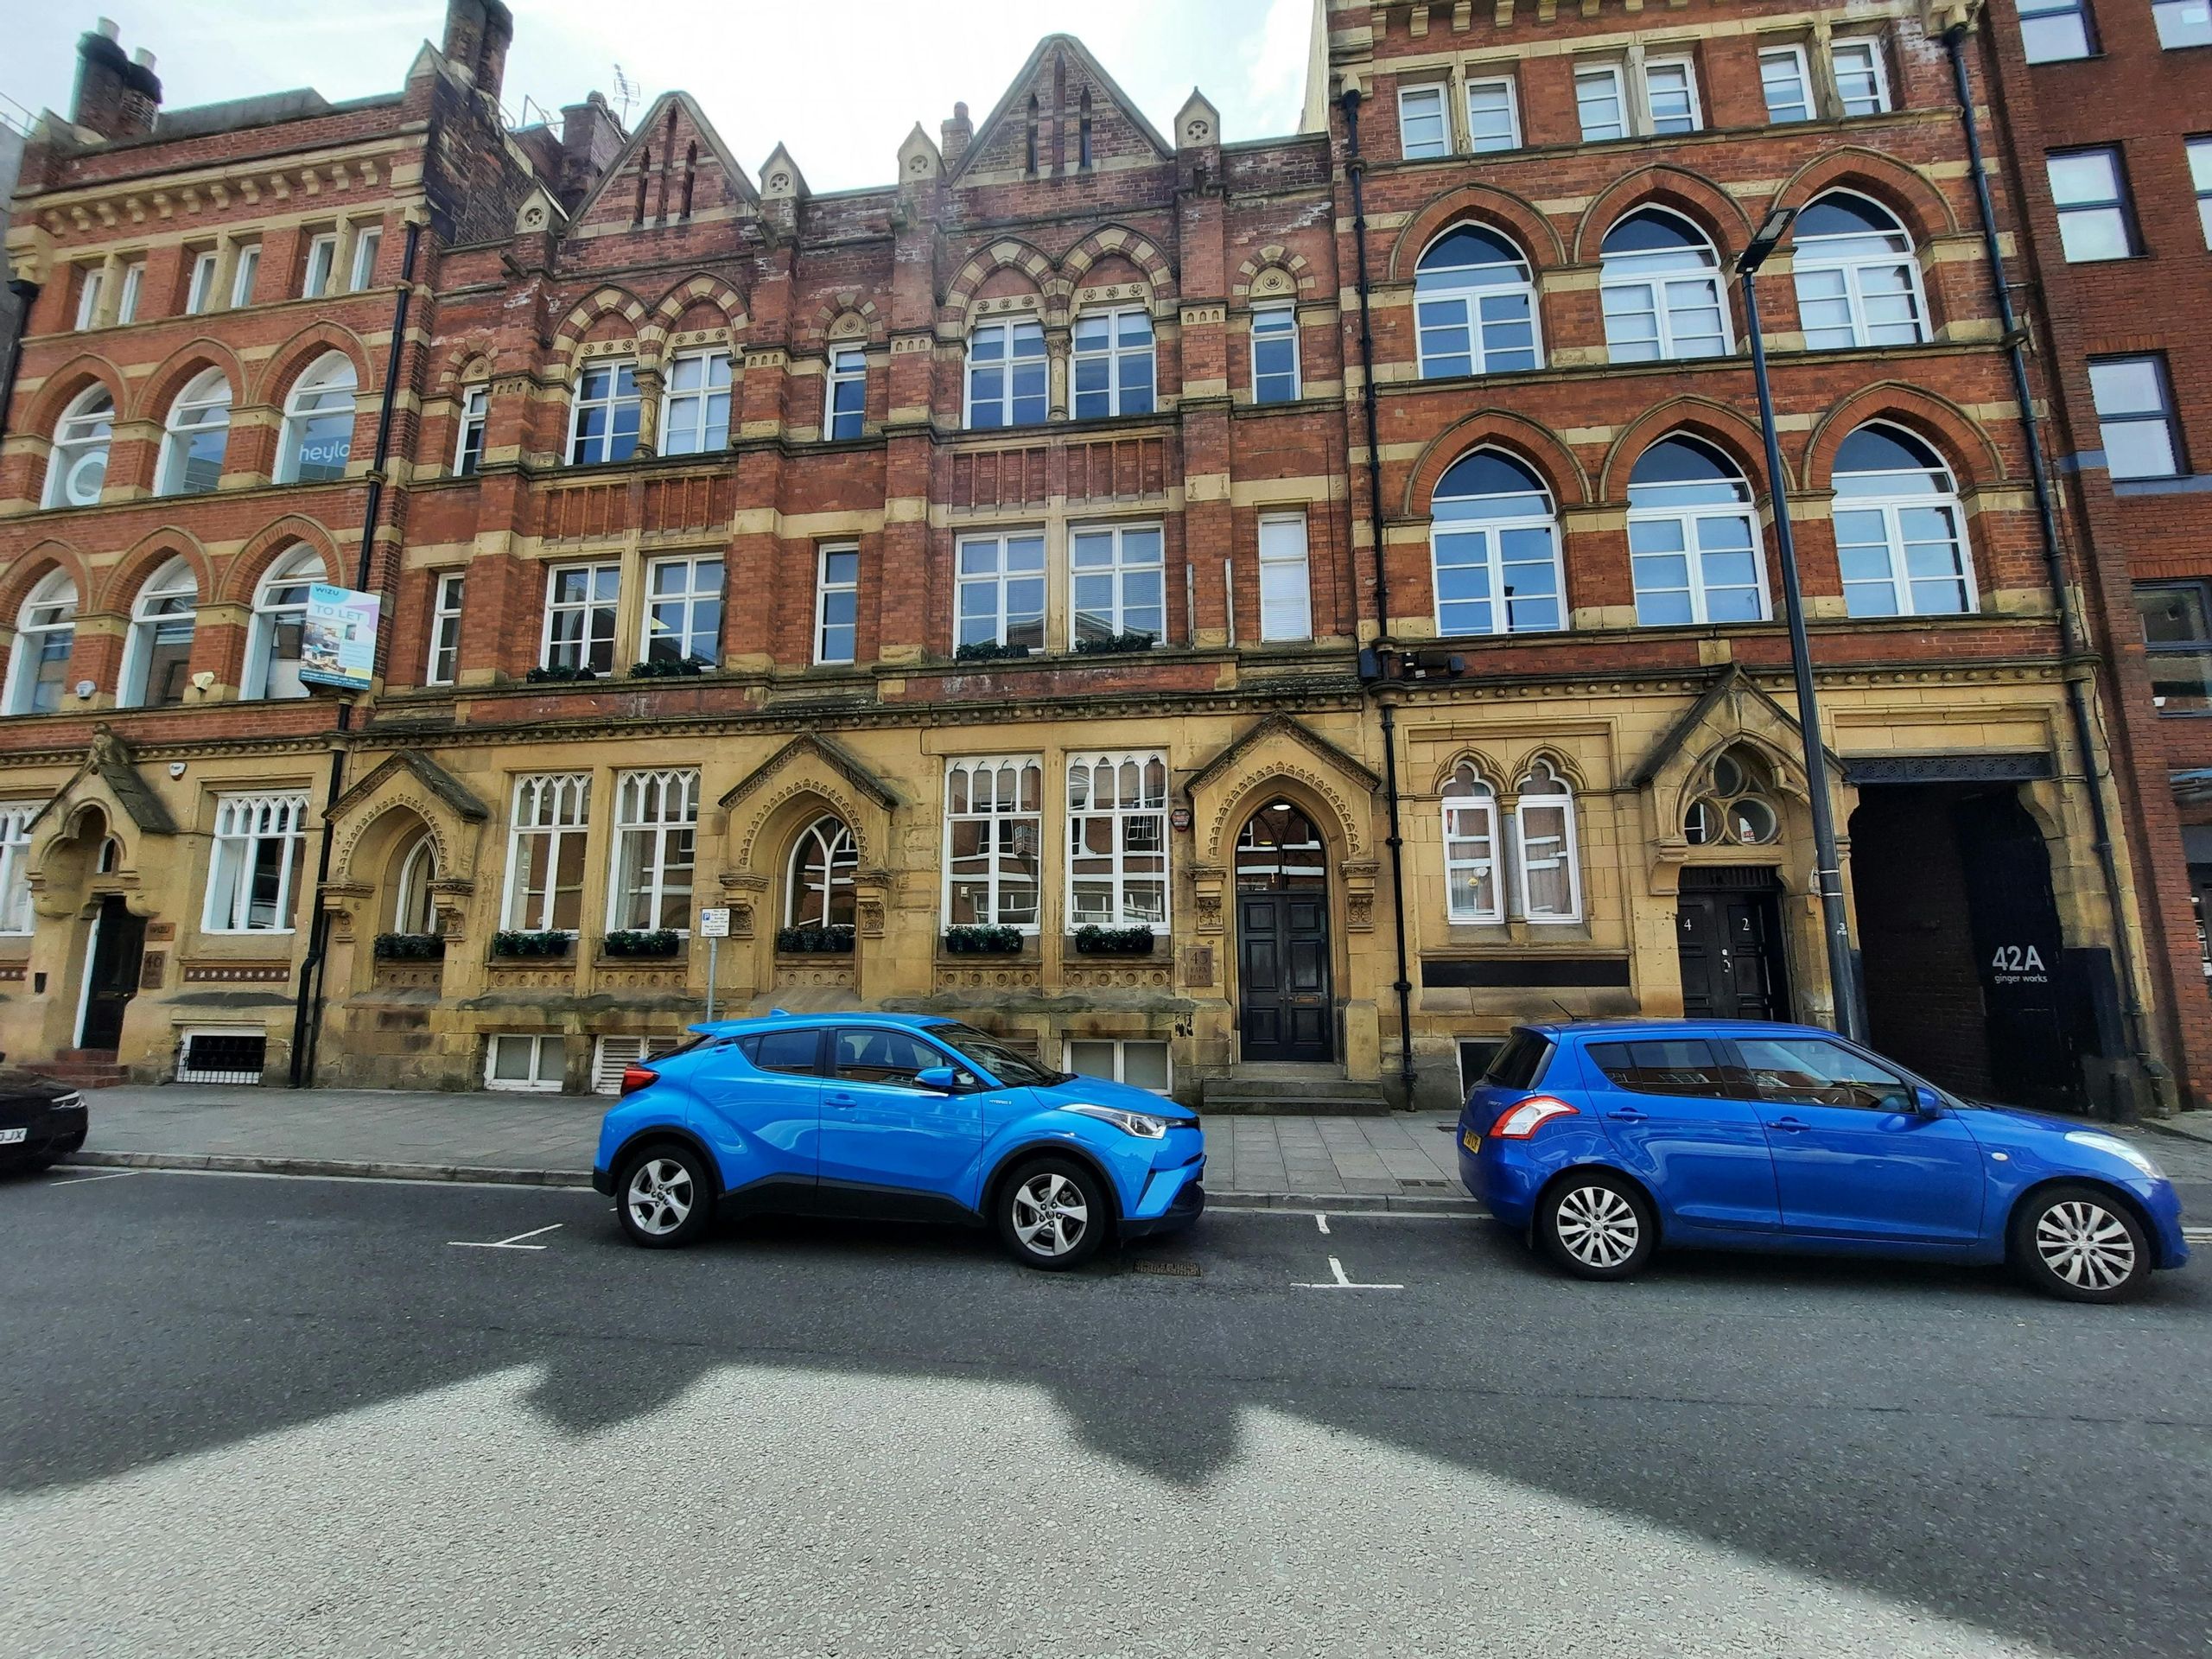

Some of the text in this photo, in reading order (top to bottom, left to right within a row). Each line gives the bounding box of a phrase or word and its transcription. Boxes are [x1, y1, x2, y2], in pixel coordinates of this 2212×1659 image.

[298, 441, 351, 463] heylo
[315, 587, 340, 596] WIZU
[315, 605, 363, 621] TO LET
[1684, 918, 1750, 931] 4 2
[1993, 945, 2045, 971] 42A
[1994, 974, 2047, 984] ginger works
